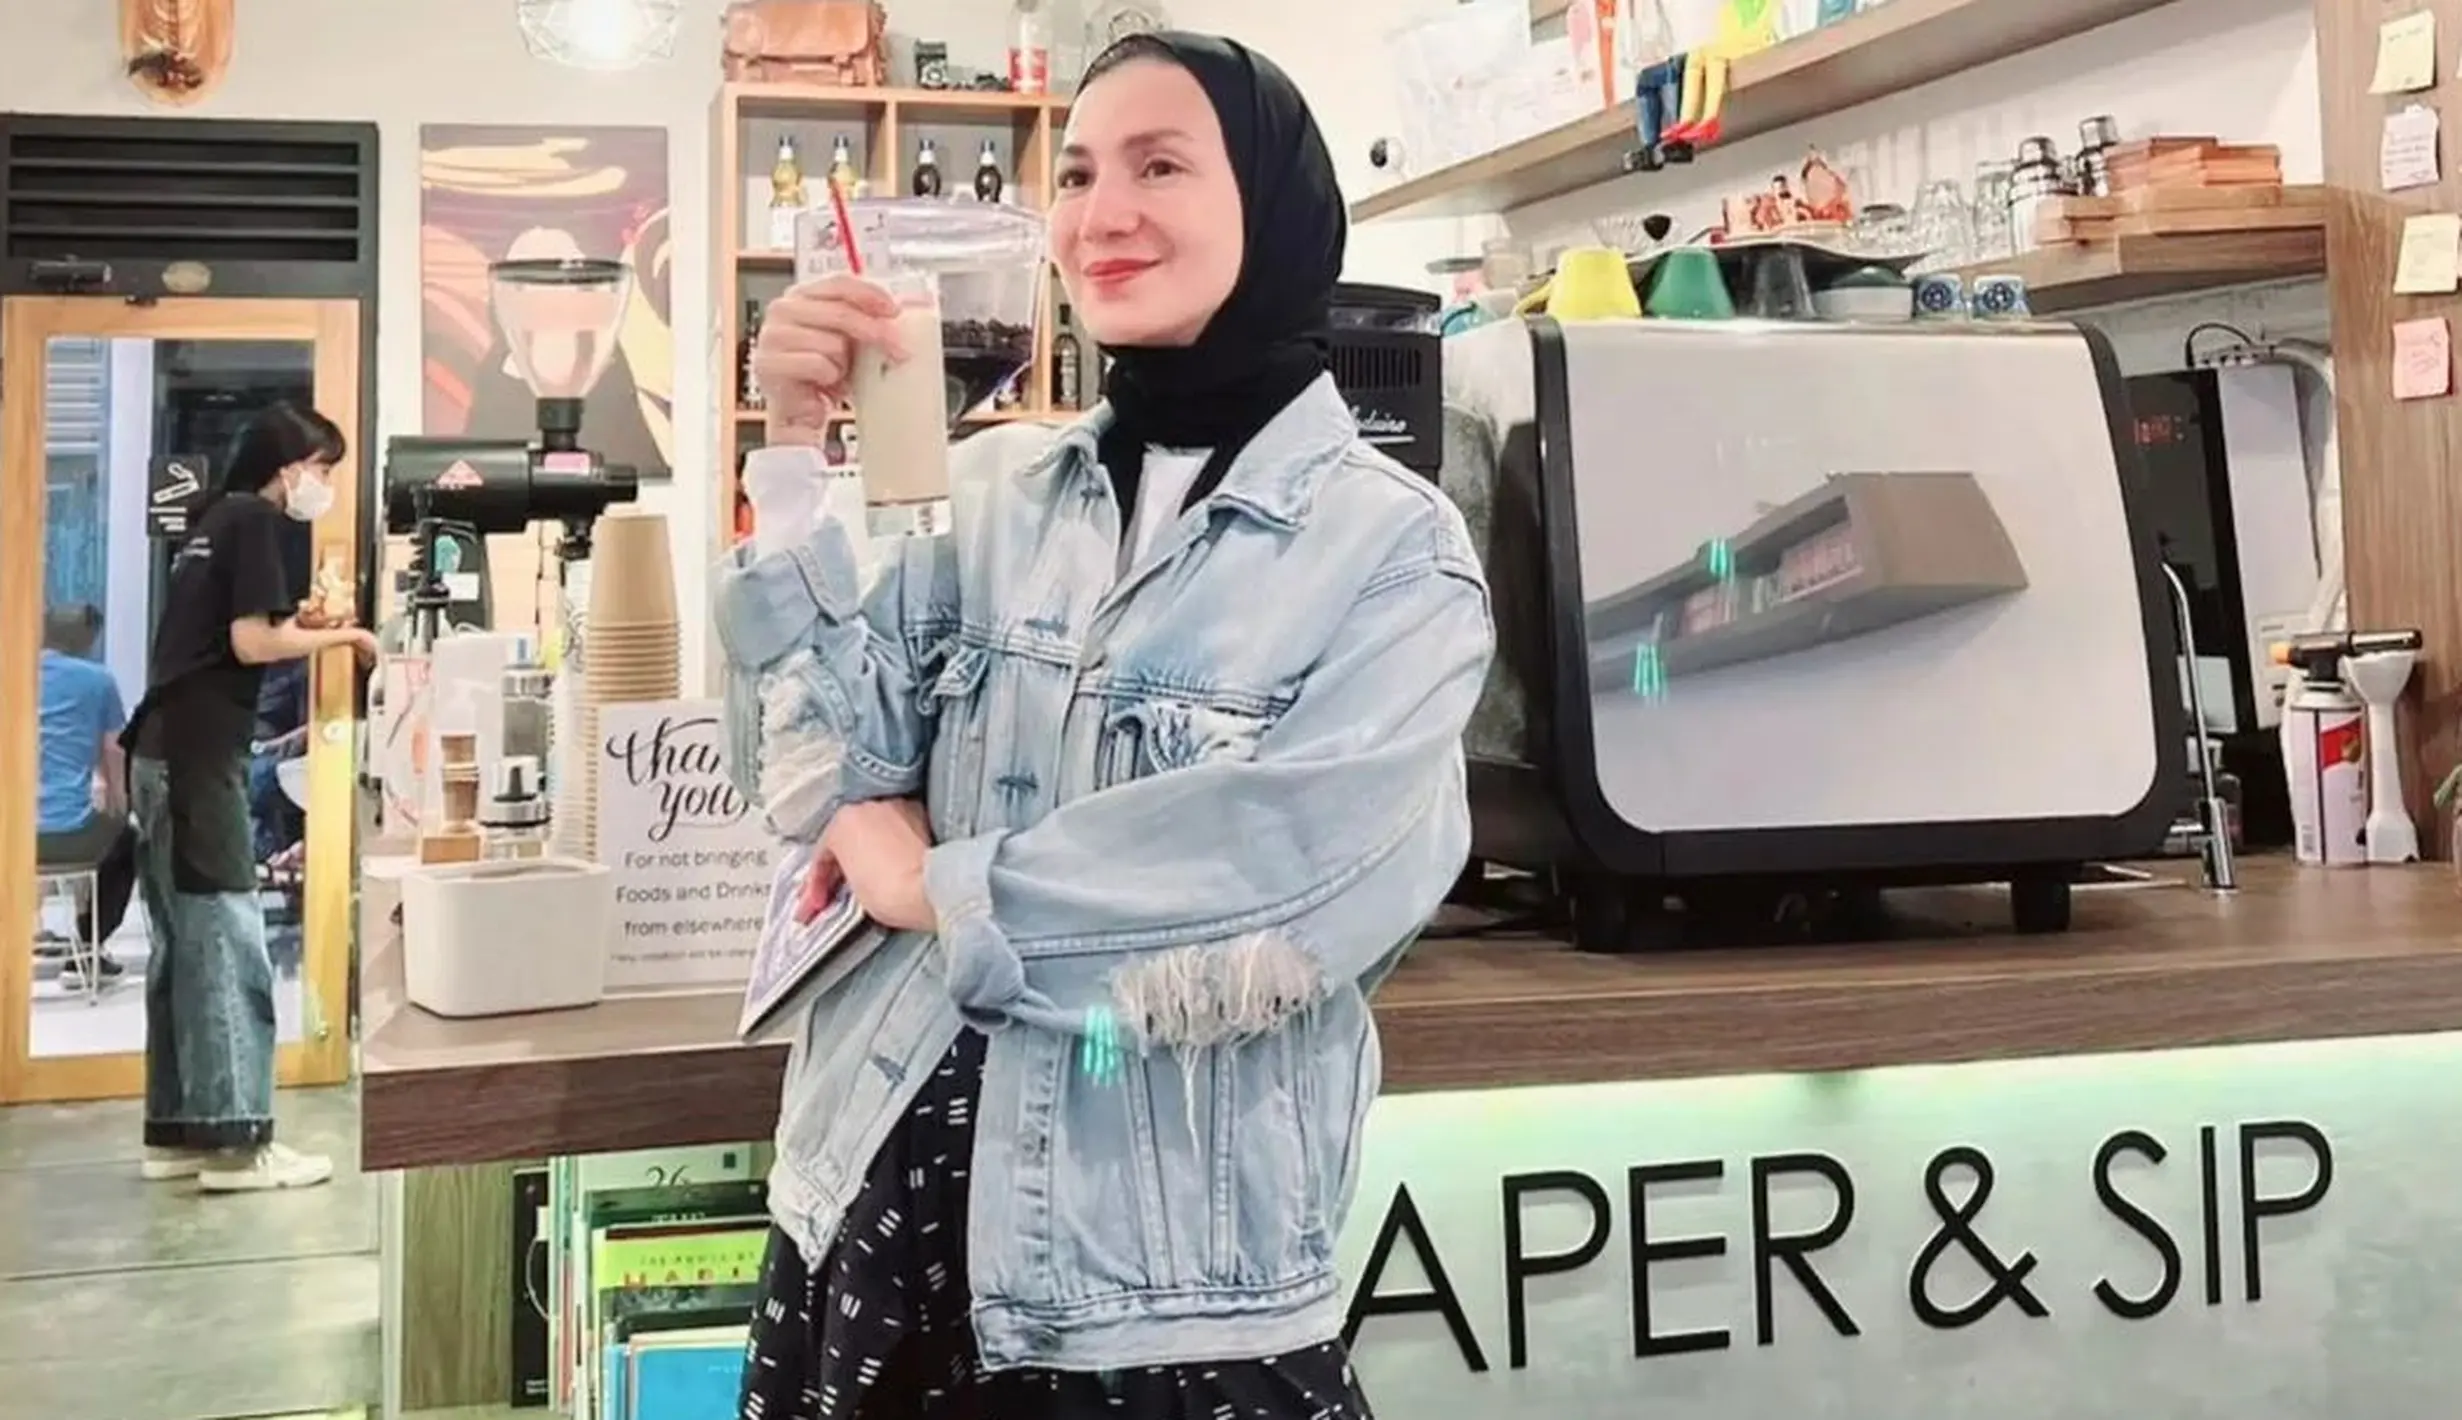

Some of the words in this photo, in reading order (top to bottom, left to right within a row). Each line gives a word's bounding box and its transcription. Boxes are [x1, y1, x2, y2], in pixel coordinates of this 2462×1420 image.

[605, 716, 720, 787] tha
[648, 780, 750, 843] you
[625, 851, 656, 869] For
[659, 851, 690, 868] not
[694, 850, 769, 869] bringing
[616, 885, 671, 904] Foods
[676, 884, 711, 901] and
[624, 920, 668, 938] from
[672, 917, 765, 936] elsewhere
[1340, 1153, 1861, 1373] APER
[1909, 1146, 2050, 1329] &
[2093, 1121, 2333, 1320] SIP
